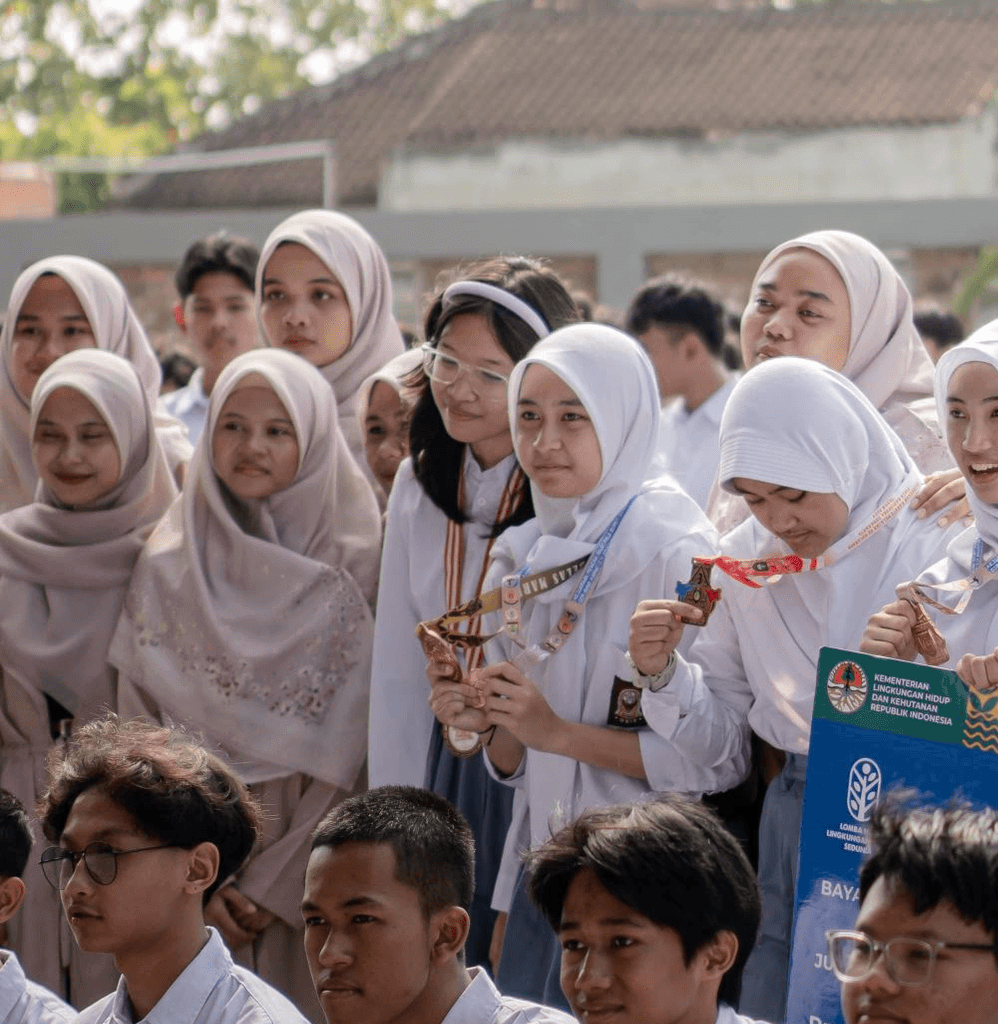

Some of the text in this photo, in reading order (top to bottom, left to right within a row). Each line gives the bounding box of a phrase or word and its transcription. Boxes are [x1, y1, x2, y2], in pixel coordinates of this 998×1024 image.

[522, 576, 548, 595] MAR
[874, 673, 930, 690] KEMENTERIAN
[871, 693, 938, 713] DAN KEHUTANAN
[873, 683, 951, 705] LINGKUNGAN HIDUP
[870, 702, 953, 726] REPUBLIK INDONESIA
[826, 829, 868, 844] LINGKUNGA
[840, 822, 862, 833] LOMBA
[821, 880, 860, 902] BAYA
